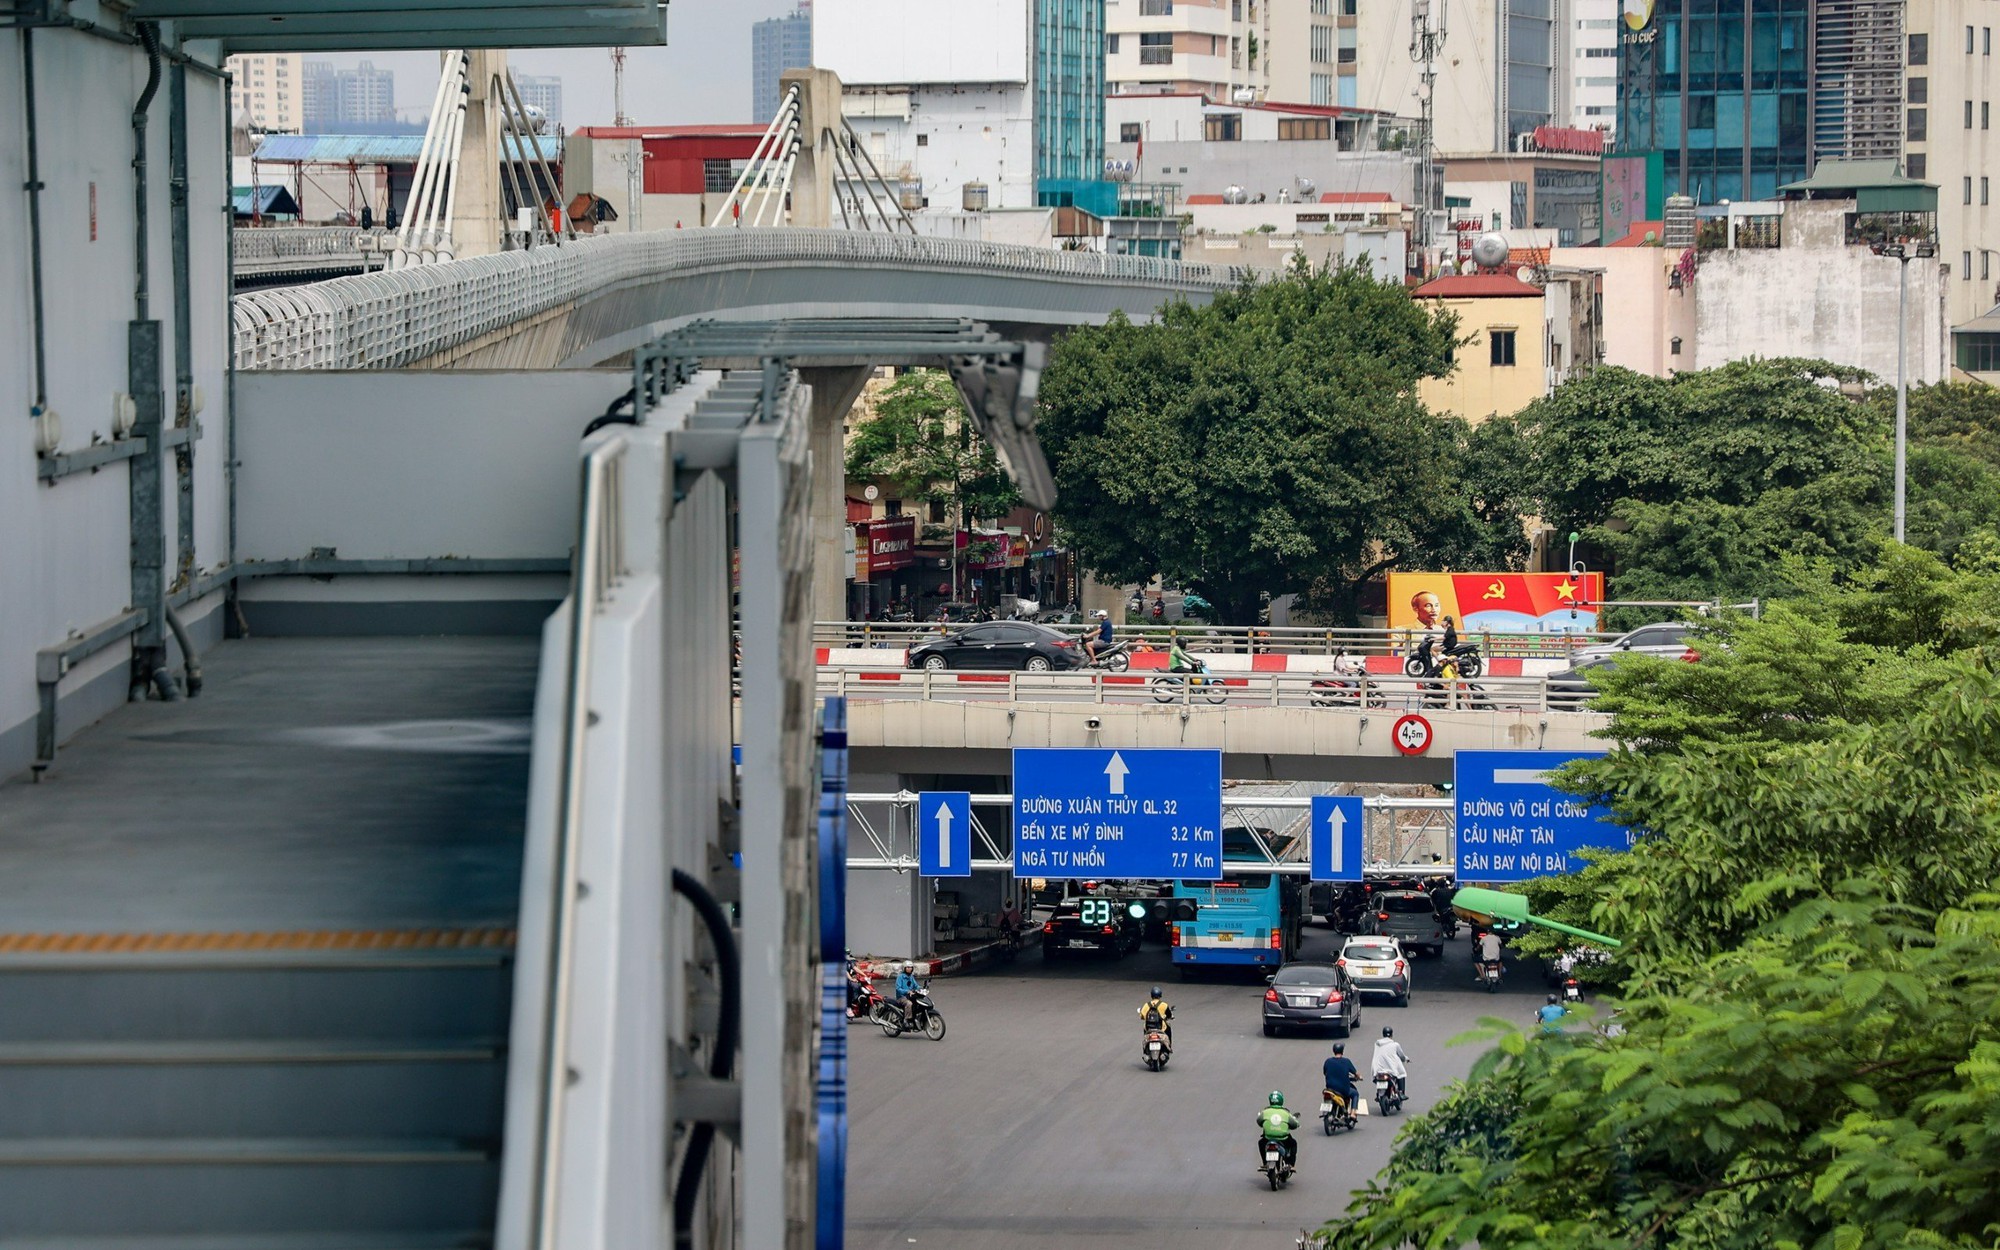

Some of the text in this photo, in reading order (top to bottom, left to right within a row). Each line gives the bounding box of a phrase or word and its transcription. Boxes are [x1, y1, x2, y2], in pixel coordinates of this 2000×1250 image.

[1402, 726, 1424, 742] 4,5m
[1021, 795, 1063, 814] ĐƯỜNG
[1067, 796, 1101, 814] XUÂN
[1106, 795, 1138, 814] THỦY
[1463, 798, 1588, 818] ĐƯỜNG VÕ CHÍ CÔNG
[1021, 819, 1214, 841] BẾN XE MỸ ĐÌNH 3.2 Km
[1463, 822, 1487, 844] CẦU
[1493, 826, 1524, 846] NHẬT
[1531, 826, 1554, 844] TÂN
[1021, 845, 1214, 868] NGÃ TƯ NHỔN 7.7 Km
[1463, 852, 1566, 873] SÂN BAY NỘI BÀI
[1081, 900, 1110, 924] 23
